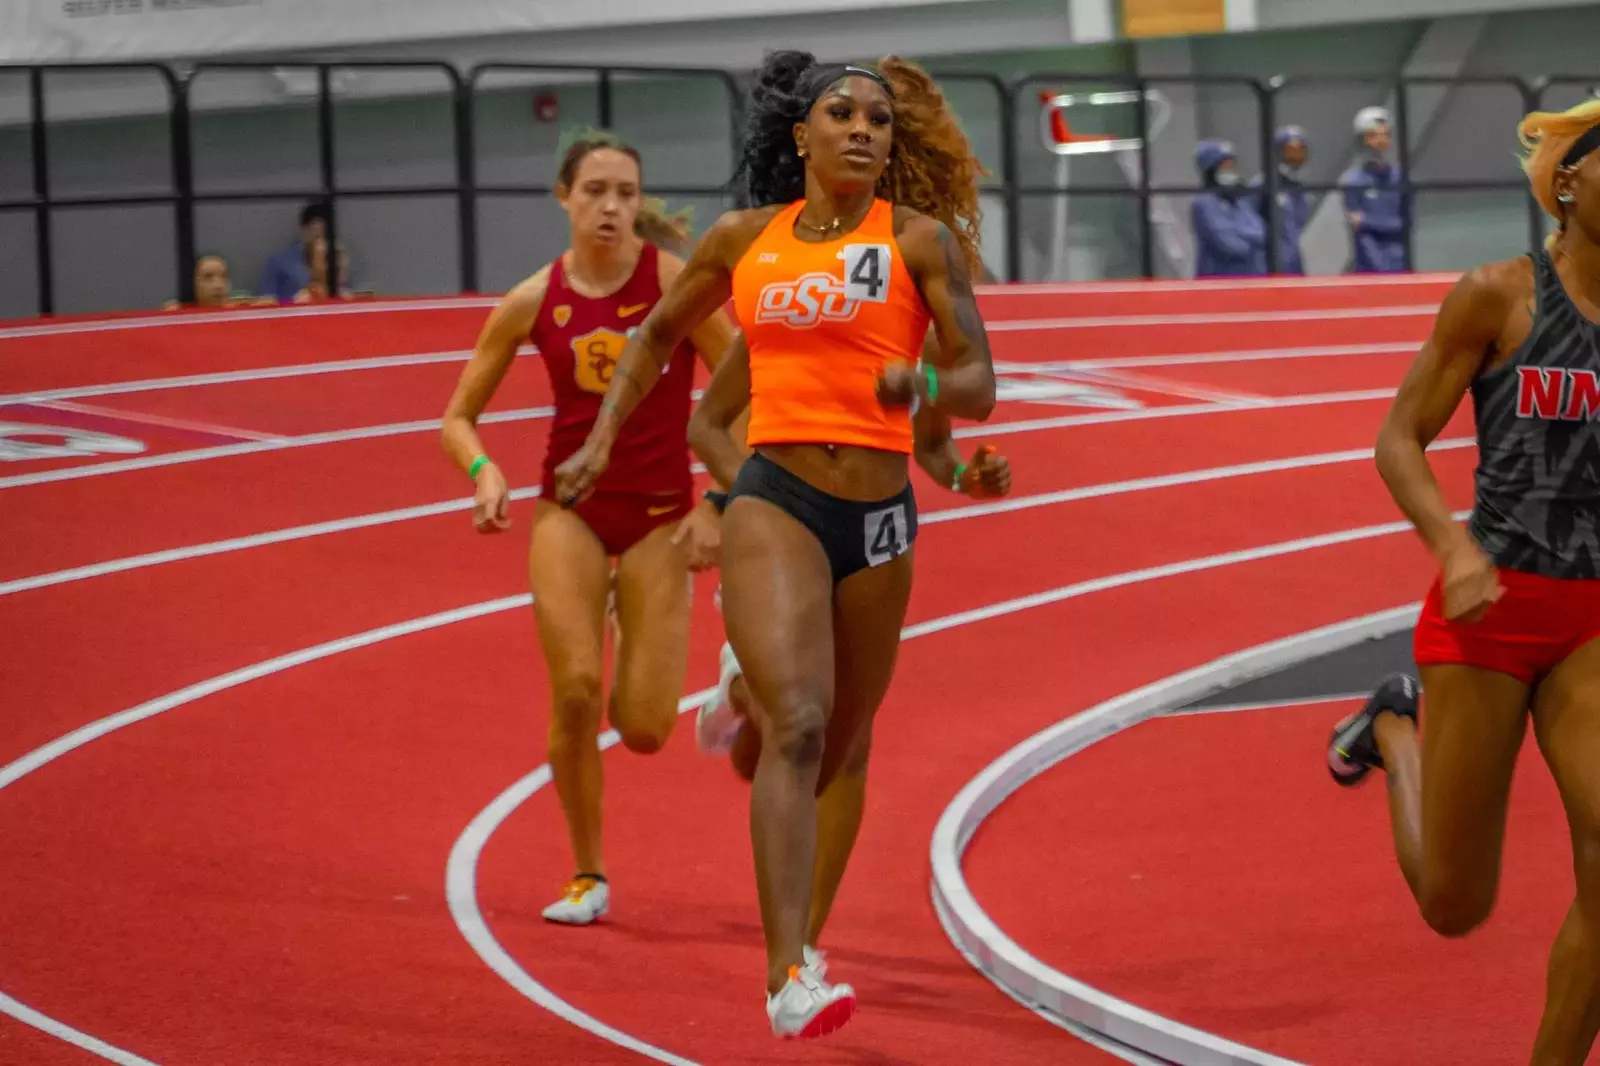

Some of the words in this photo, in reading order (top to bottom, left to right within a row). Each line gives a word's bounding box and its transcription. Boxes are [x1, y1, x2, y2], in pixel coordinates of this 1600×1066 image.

[850, 246, 884, 298] 4
[756, 272, 860, 329] OSU
[870, 511, 902, 558] 4
